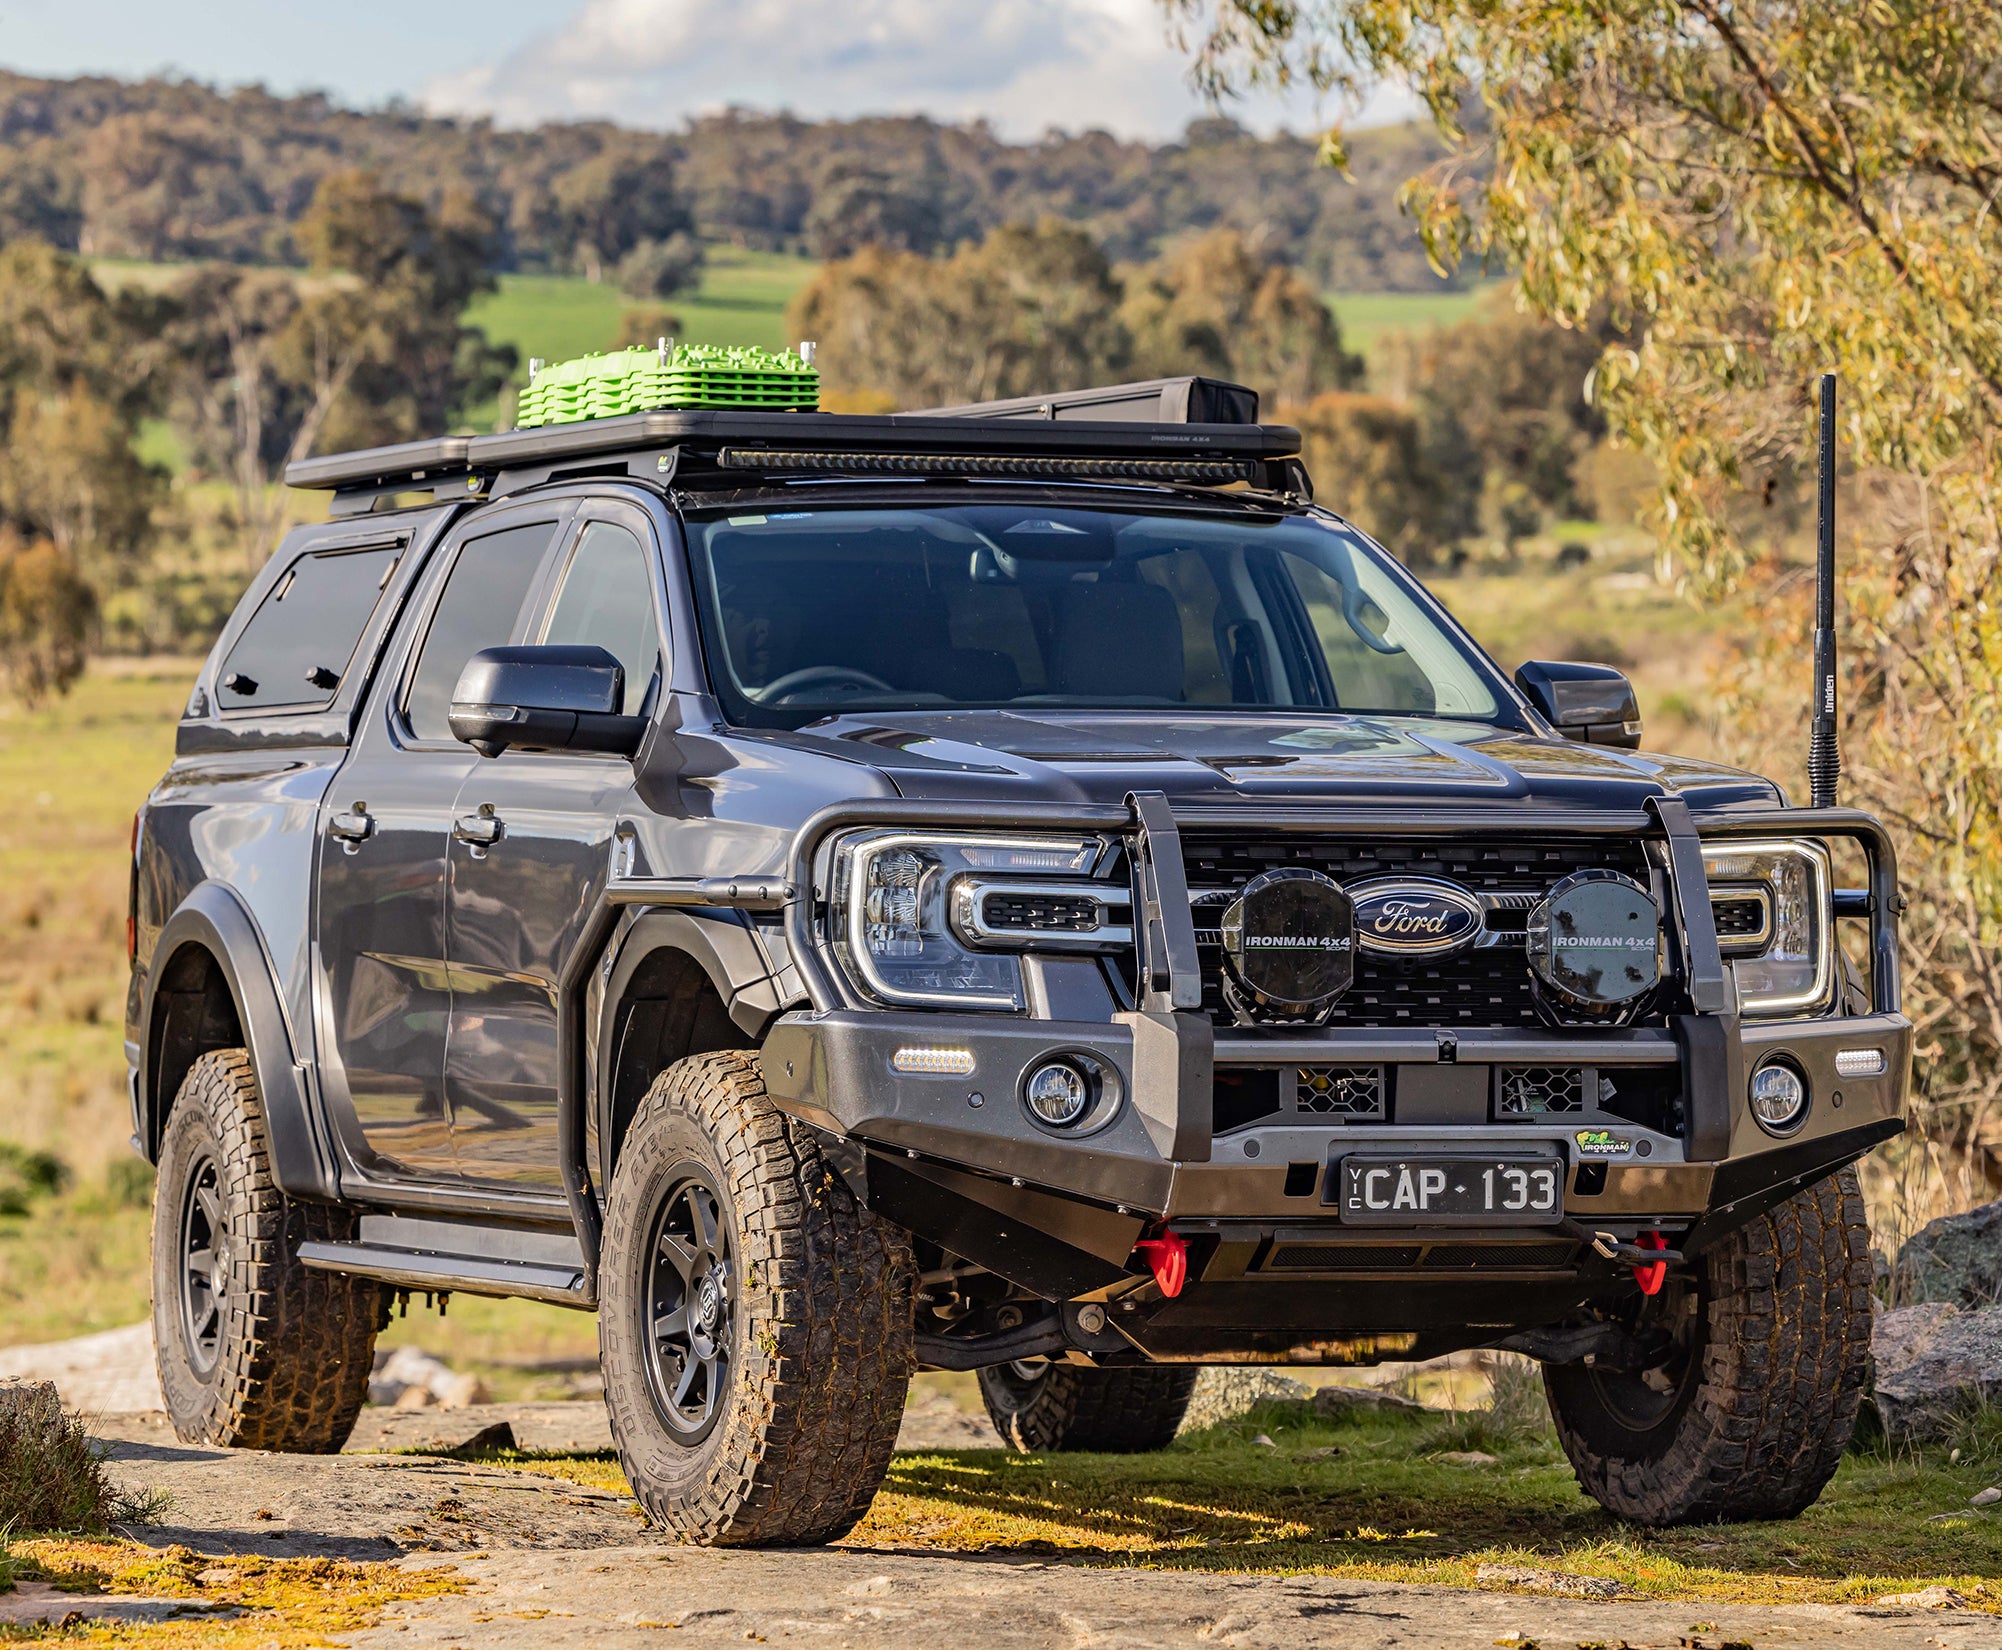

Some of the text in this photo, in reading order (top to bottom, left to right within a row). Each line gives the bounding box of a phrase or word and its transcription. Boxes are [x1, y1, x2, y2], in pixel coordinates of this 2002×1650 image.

[1825, 675, 1835, 713] Uniden
[1374, 900, 1449, 933] Ford
[1245, 936, 1351, 947] IRONMAN 4x4
[1552, 937, 1656, 947] IRONMAN 4x4
[1349, 1168, 1362, 1209] VIC
[1365, 1169, 1555, 1210] CAP 133
[605, 1192, 636, 1437] DISCOVERER
